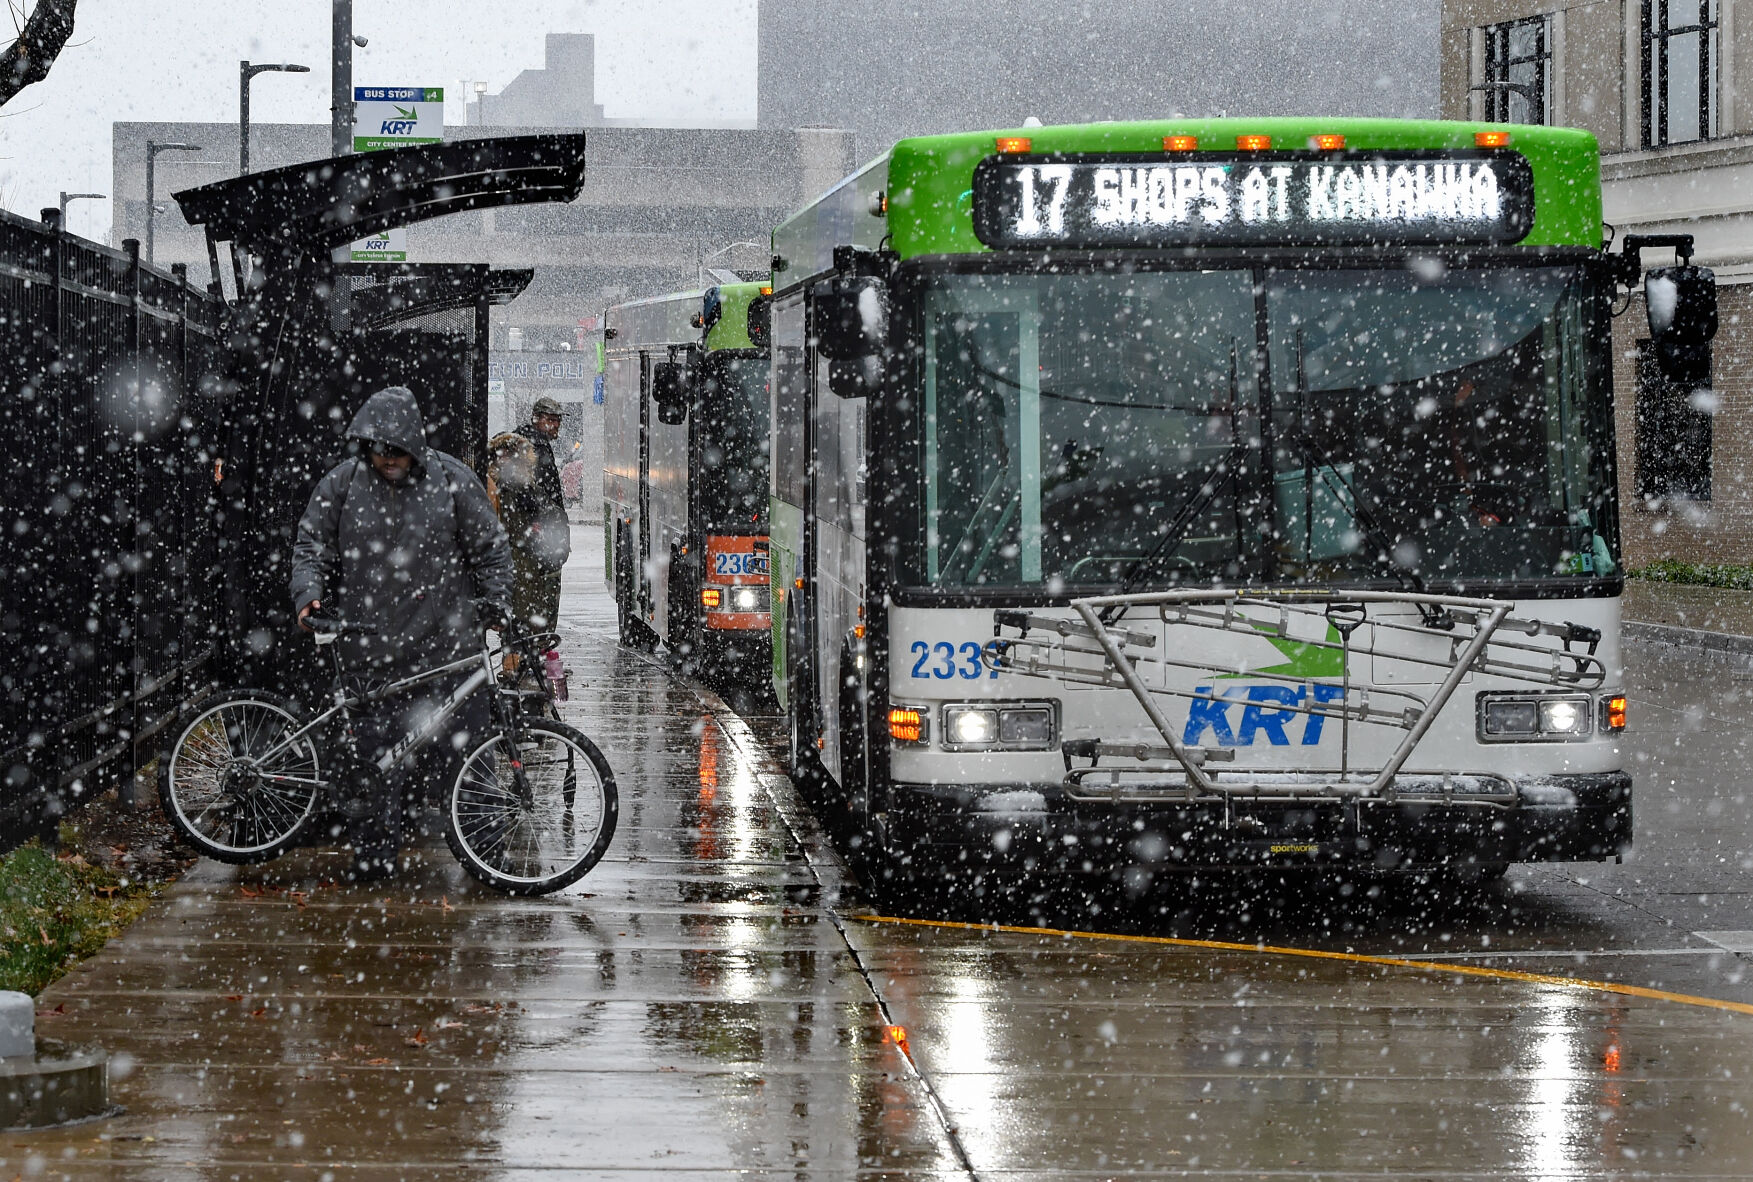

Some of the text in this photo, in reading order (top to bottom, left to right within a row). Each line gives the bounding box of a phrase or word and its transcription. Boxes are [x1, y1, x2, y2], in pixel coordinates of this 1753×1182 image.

[364, 90, 385, 98] BUS
[388, 90, 414, 98] STOP
[380, 121, 417, 134] KRT
[1015, 164, 1498, 235] 17 SHOPS AT KANAWHA
[366, 240, 390, 249] KRT
[1182, 685, 1349, 746] KRT
[1270, 844, 1318, 853] sportworks
